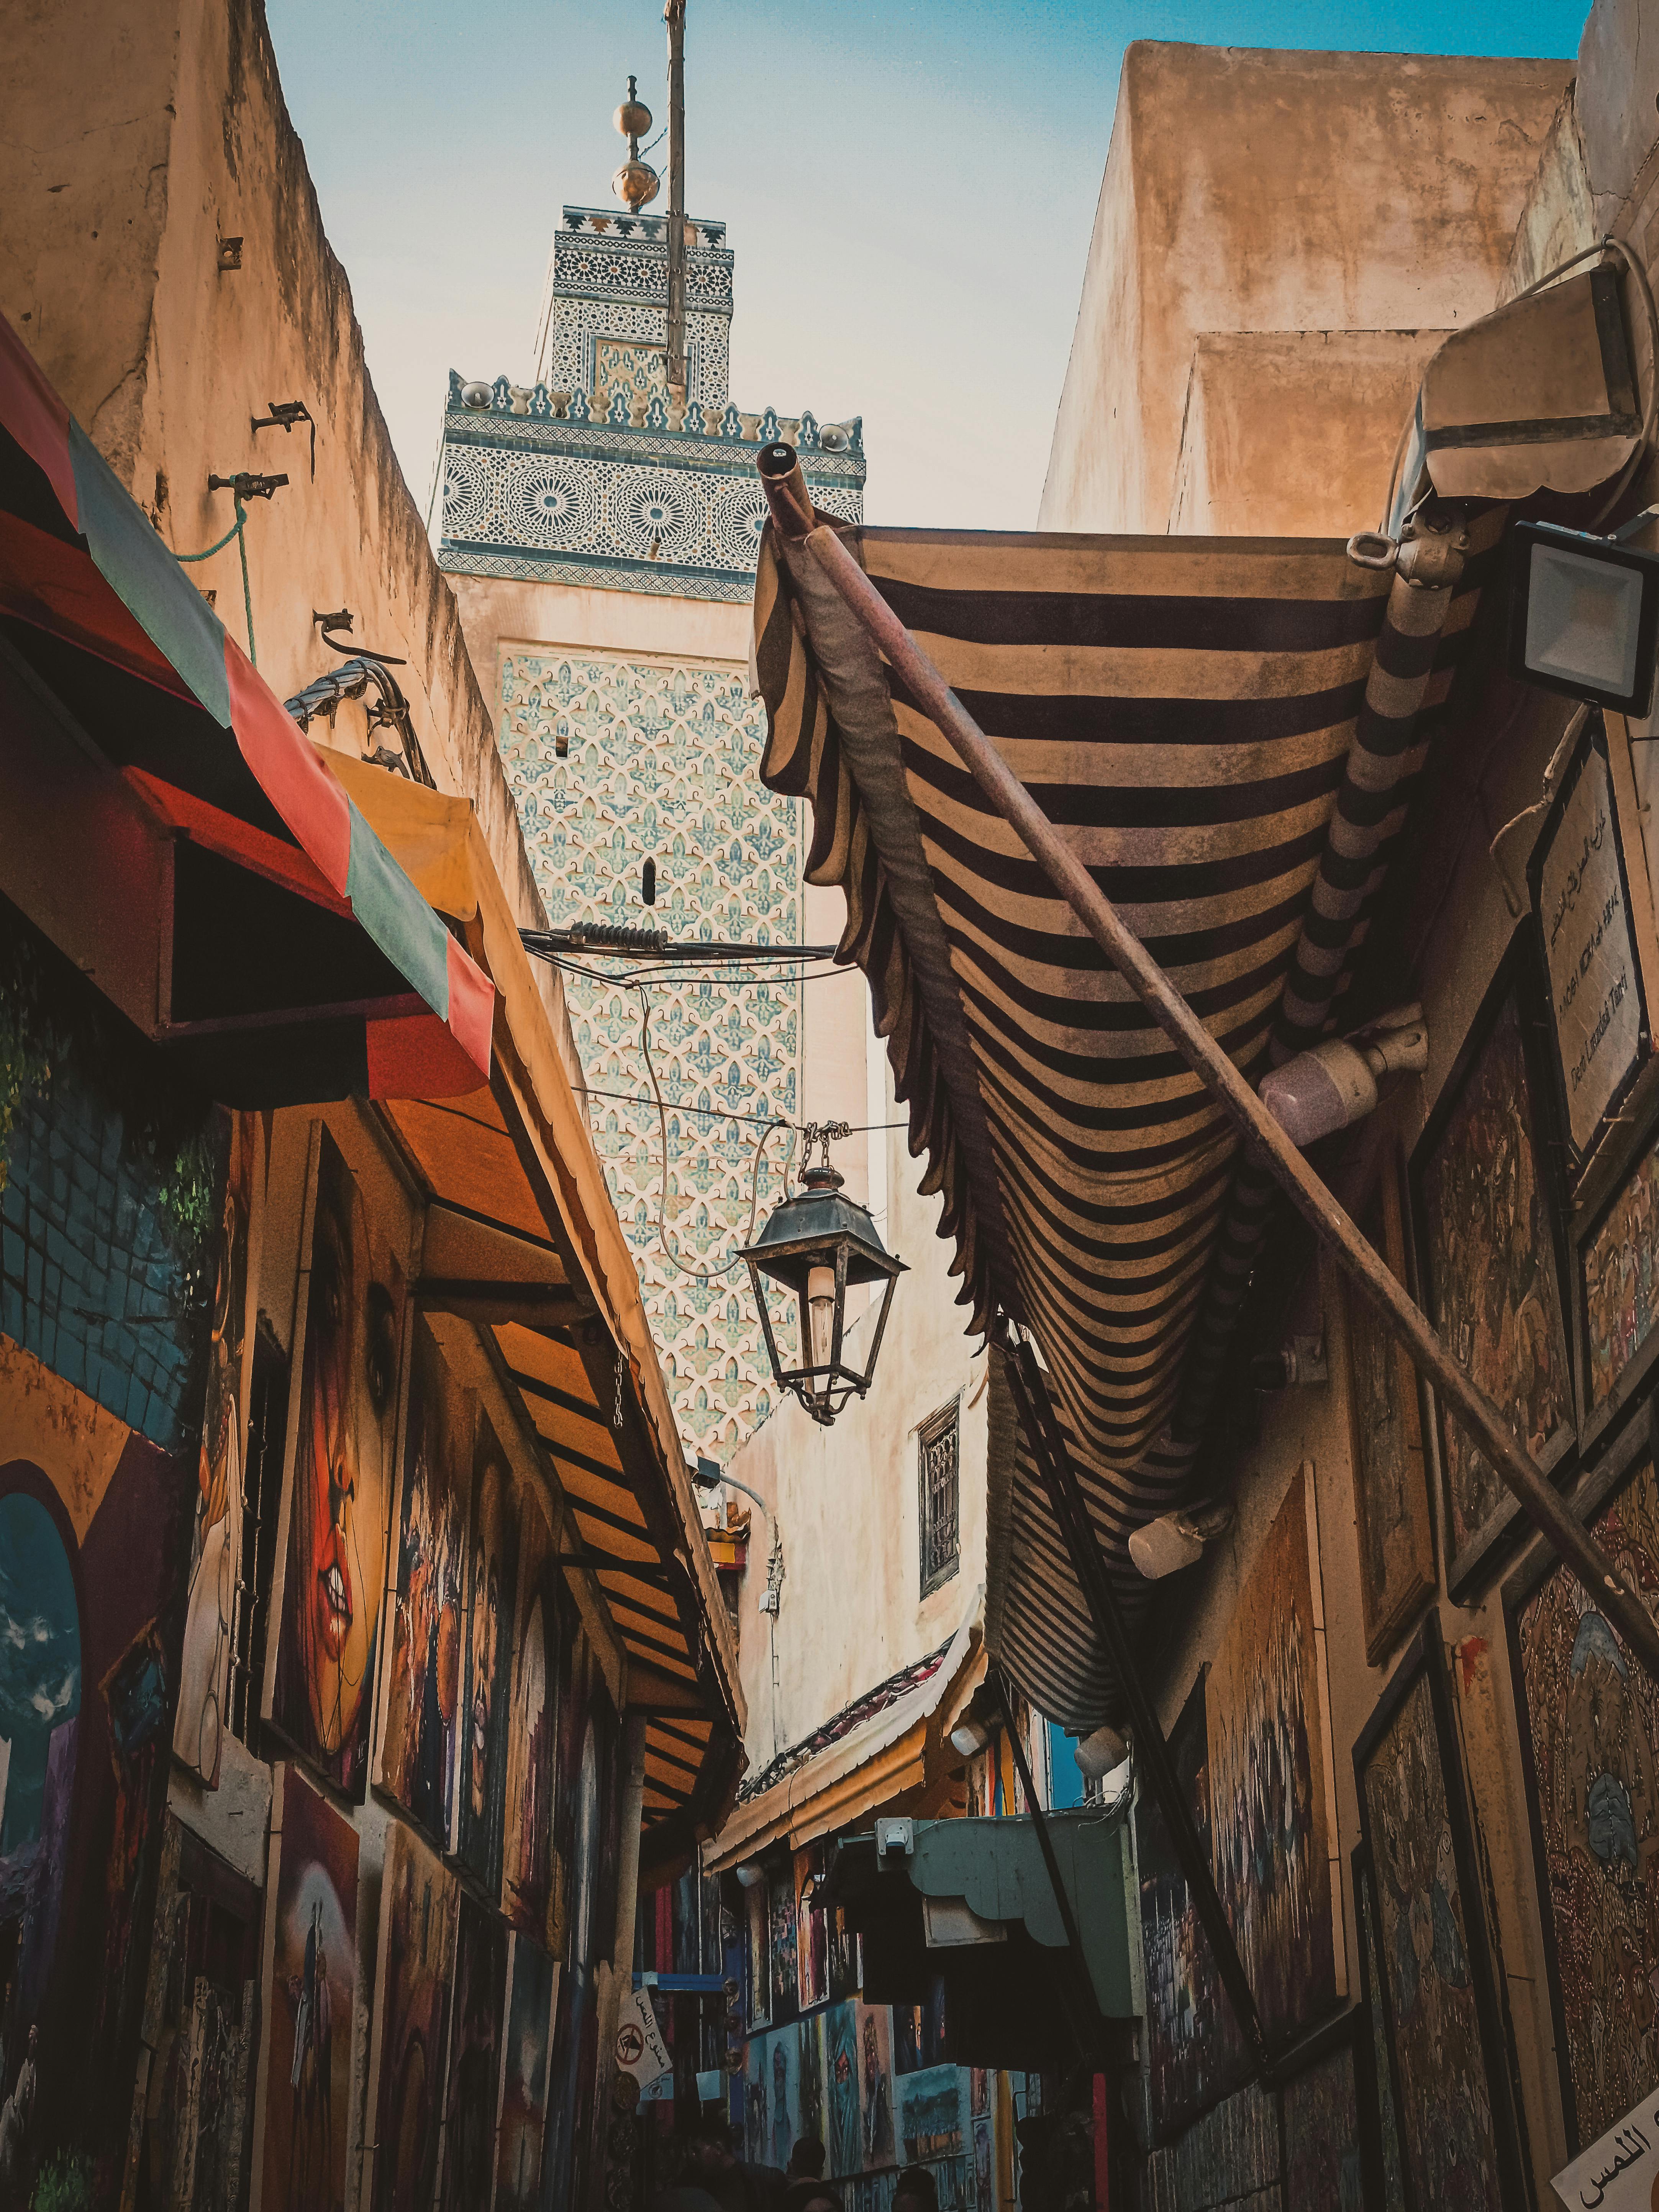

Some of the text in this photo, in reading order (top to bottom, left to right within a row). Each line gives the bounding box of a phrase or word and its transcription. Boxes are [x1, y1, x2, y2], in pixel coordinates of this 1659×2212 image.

[1571, 1050, 1586, 1092] Derb
[635, 1996, 654, 2028] اللمس
[645, 2032, 665, 2069] ممنوع
[1579, 2123, 1651, 2210] اللمس
